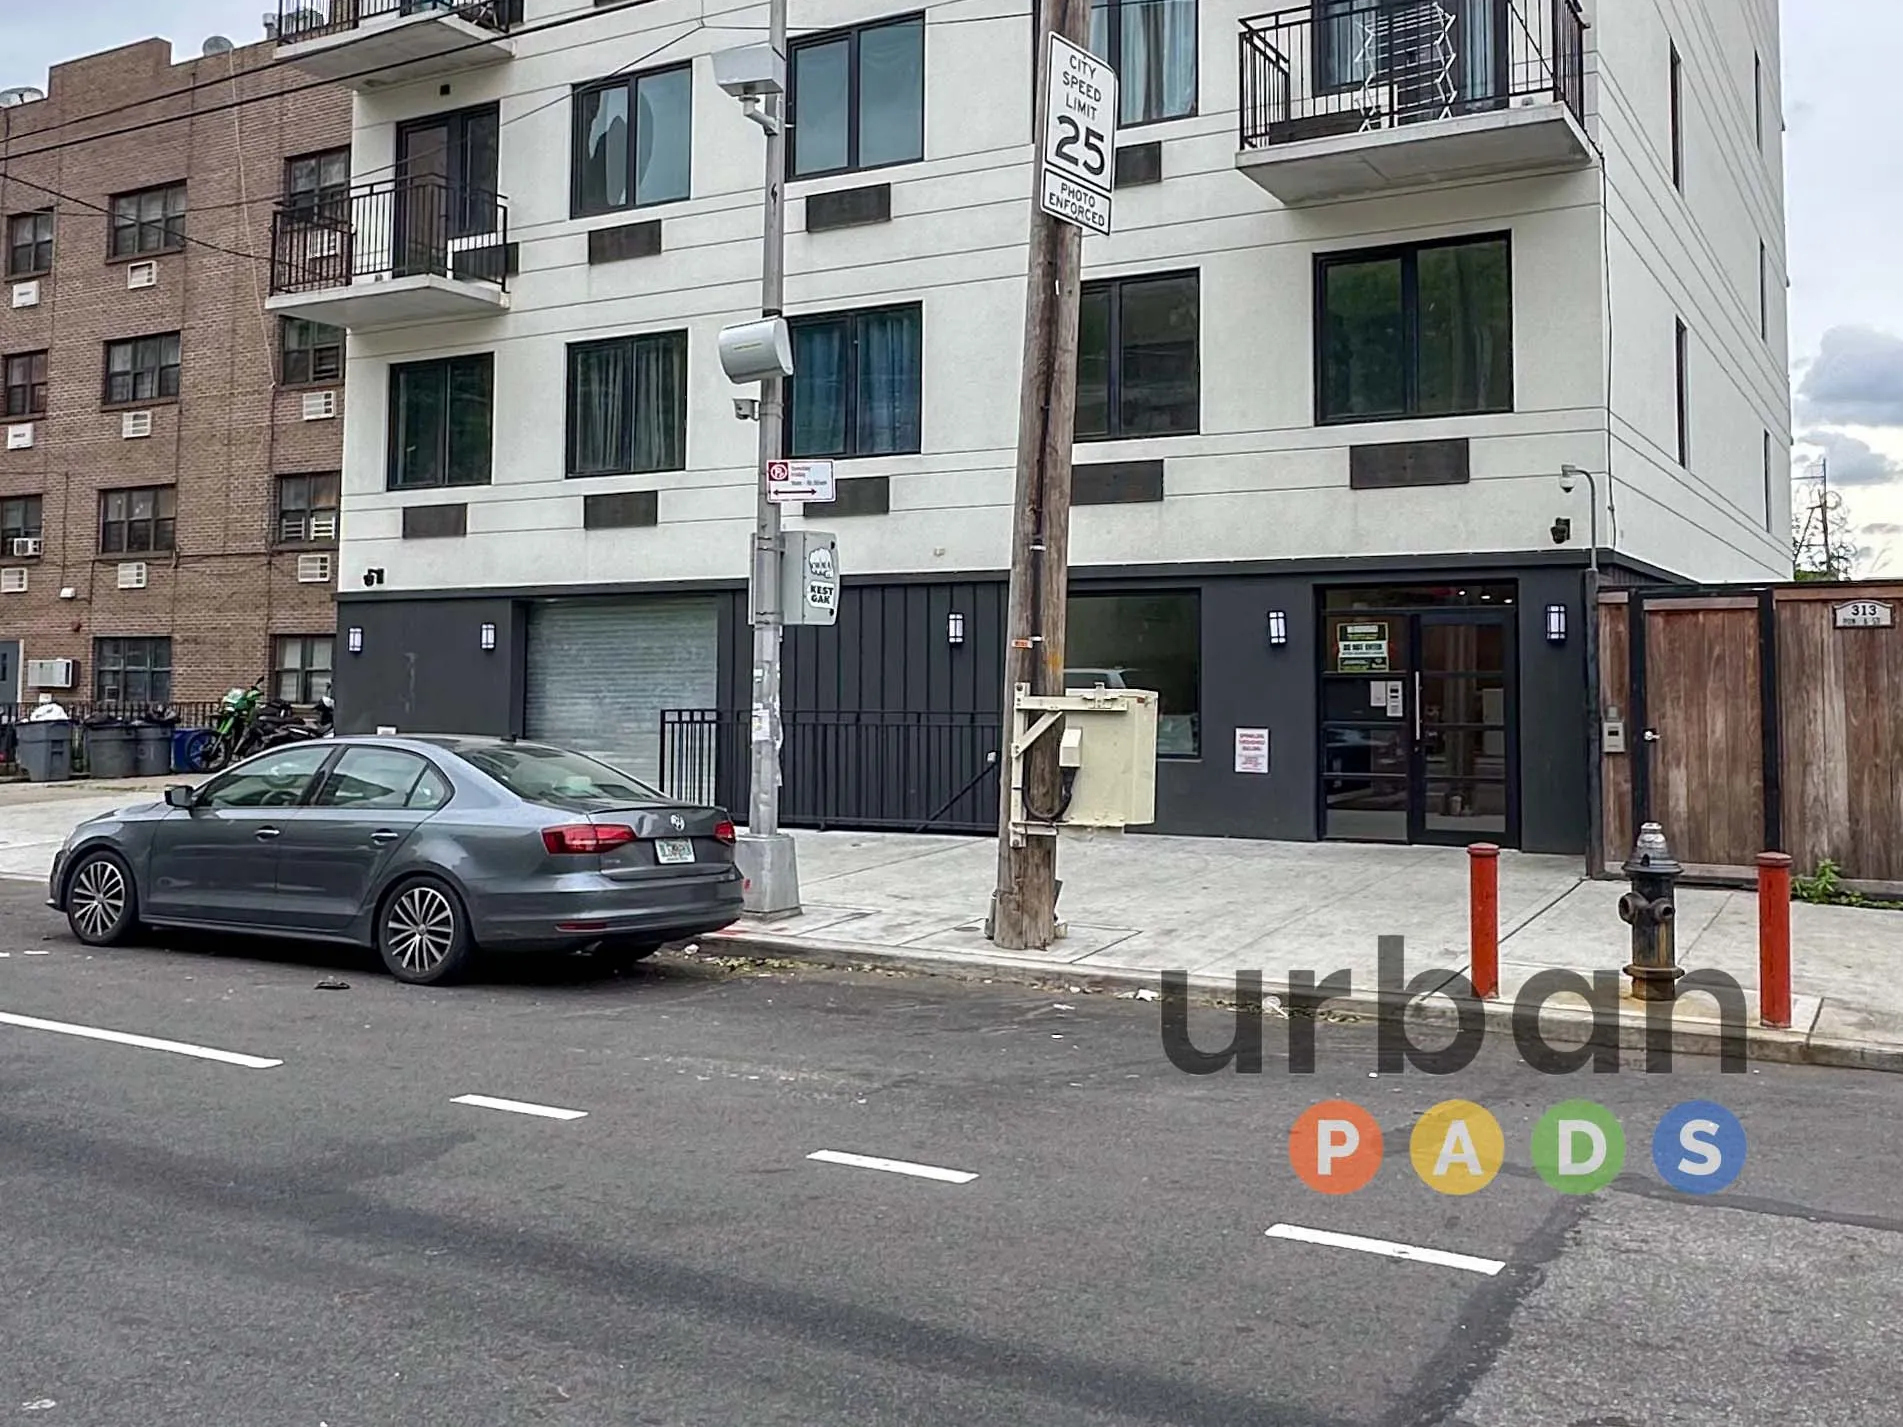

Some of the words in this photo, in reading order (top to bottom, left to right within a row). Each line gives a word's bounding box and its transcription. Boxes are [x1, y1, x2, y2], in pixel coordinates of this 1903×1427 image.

[1069, 54, 1096, 79] CITY
[1062, 71, 1101, 103] SPEED
[1065, 93, 1097, 121] LIMIT
[1055, 115, 1105, 176] 25
[1060, 182, 1096, 208] PHOTO
[1049, 193, 1105, 227] ENFORCED
[1851, 604, 1877, 616] 313
